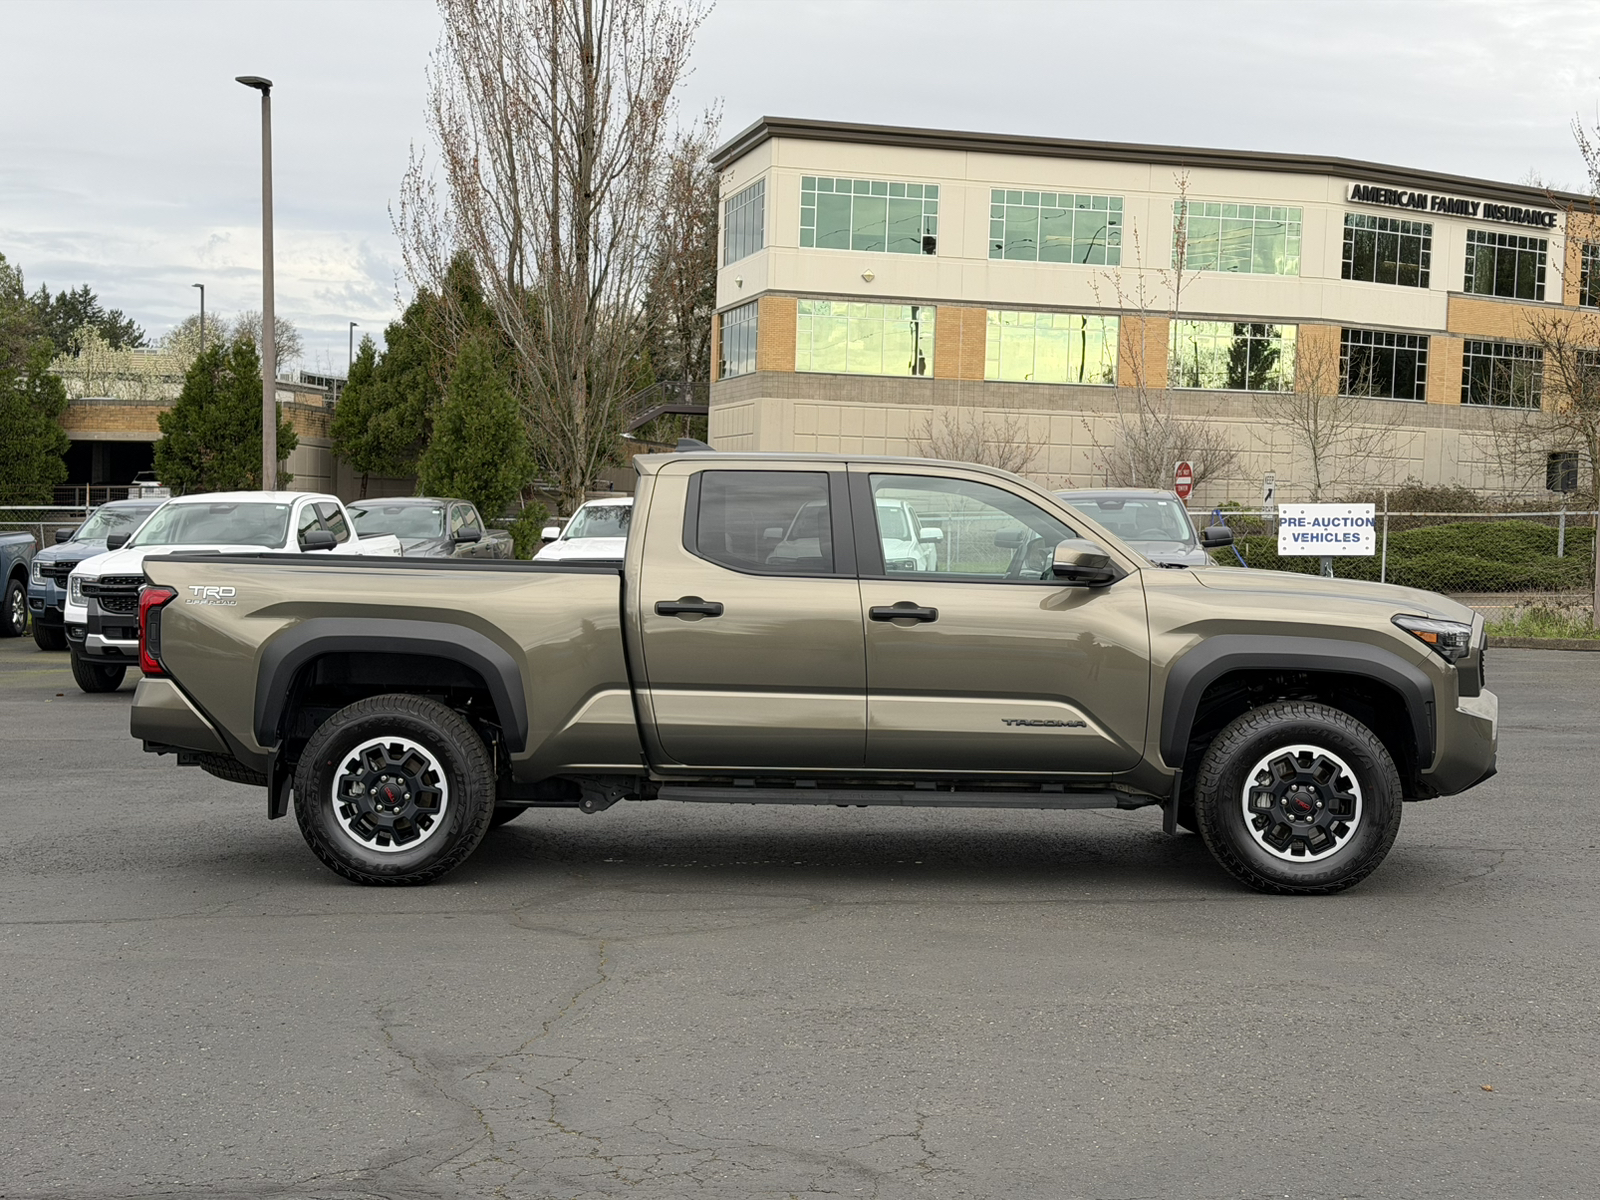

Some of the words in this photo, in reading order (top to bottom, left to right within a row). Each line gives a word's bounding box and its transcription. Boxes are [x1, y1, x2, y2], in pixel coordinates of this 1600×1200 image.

[1351, 184, 1428, 210] AMERICAN
[1431, 195, 1481, 217] FAMILY
[1483, 203, 1558, 228] INSURANCE
[1279, 517, 1376, 527] PRE-AUCTION
[1292, 533, 1361, 543] VEHICLES
[188, 585, 236, 600] TRD
[1001, 718, 1087, 728] TACOMA
